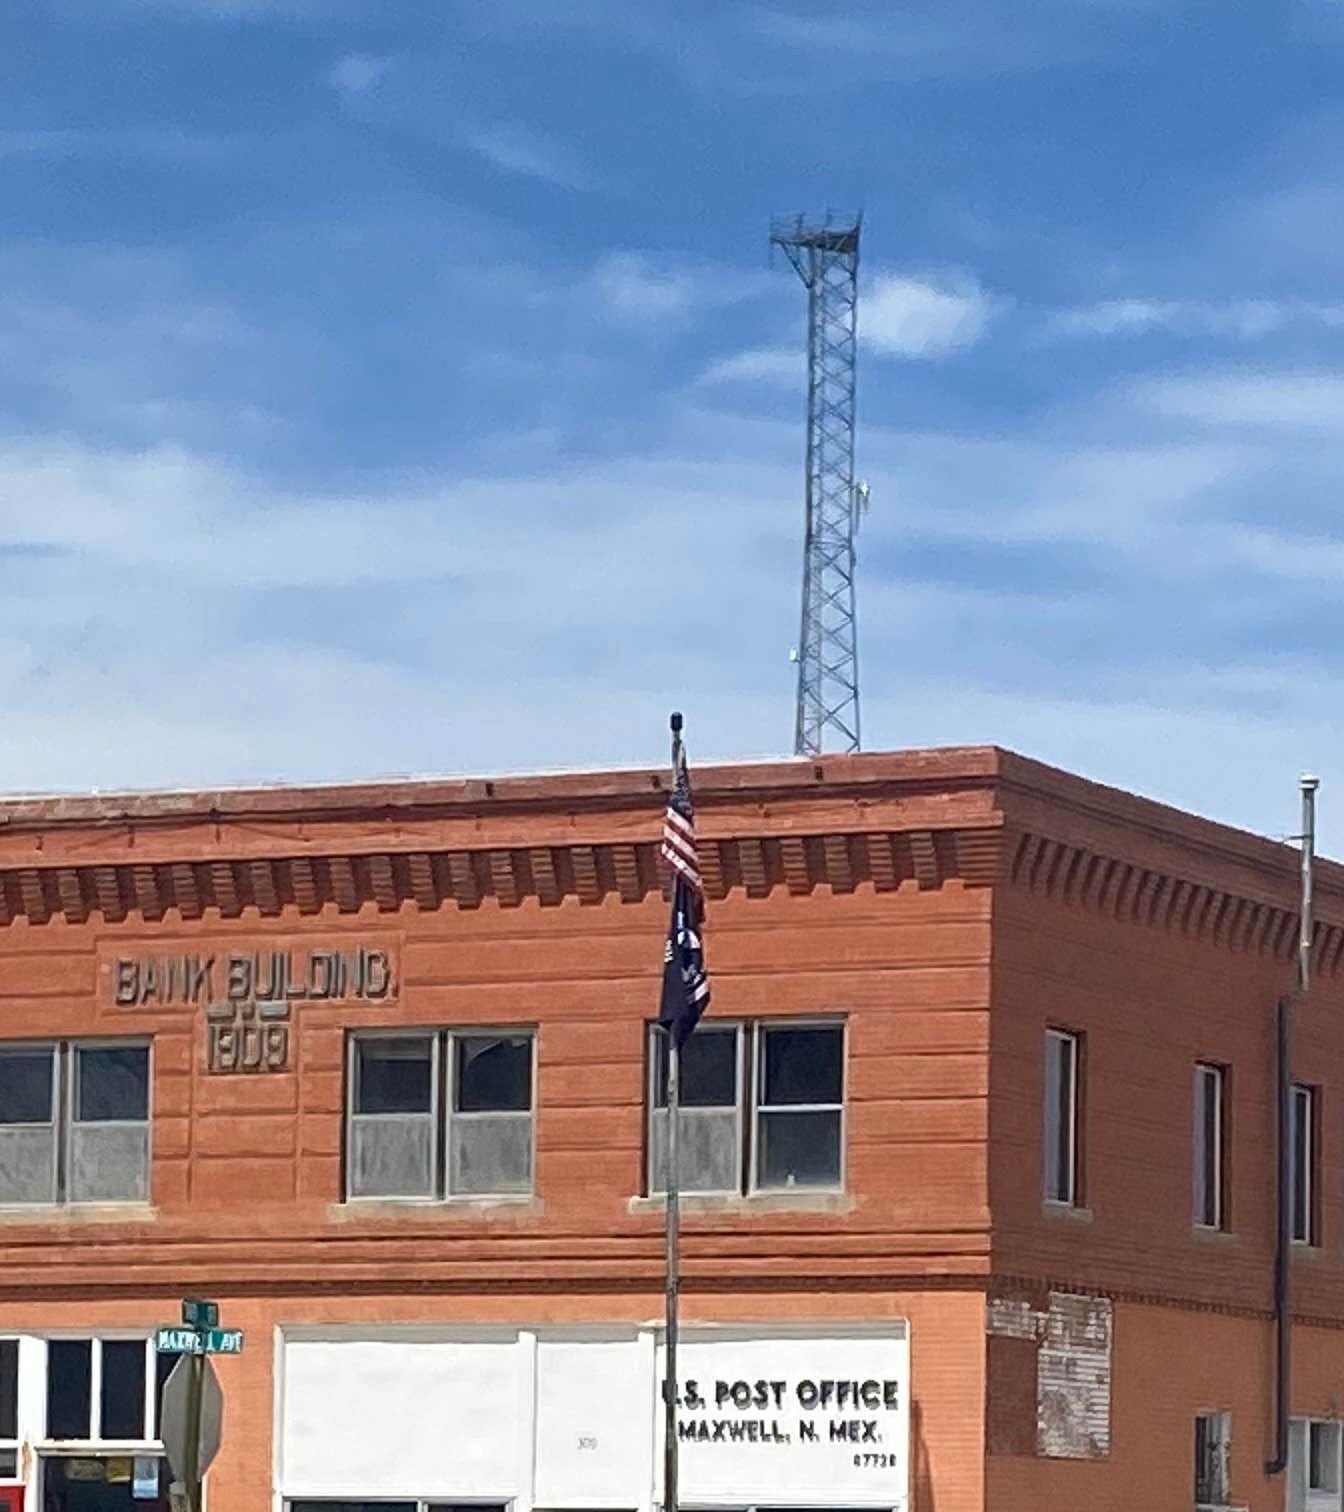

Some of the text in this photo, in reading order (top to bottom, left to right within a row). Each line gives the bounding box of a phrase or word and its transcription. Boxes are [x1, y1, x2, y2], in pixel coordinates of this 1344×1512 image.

[114, 954, 215, 1006] BANK
[159, 1330, 215, 1350] MAXWEL
[715, 1380, 787, 1410] POST
[796, 1379, 898, 1411] OFFICE
[799, 1419, 820, 1444] N.
[829, 1419, 883, 1444] MEX.
